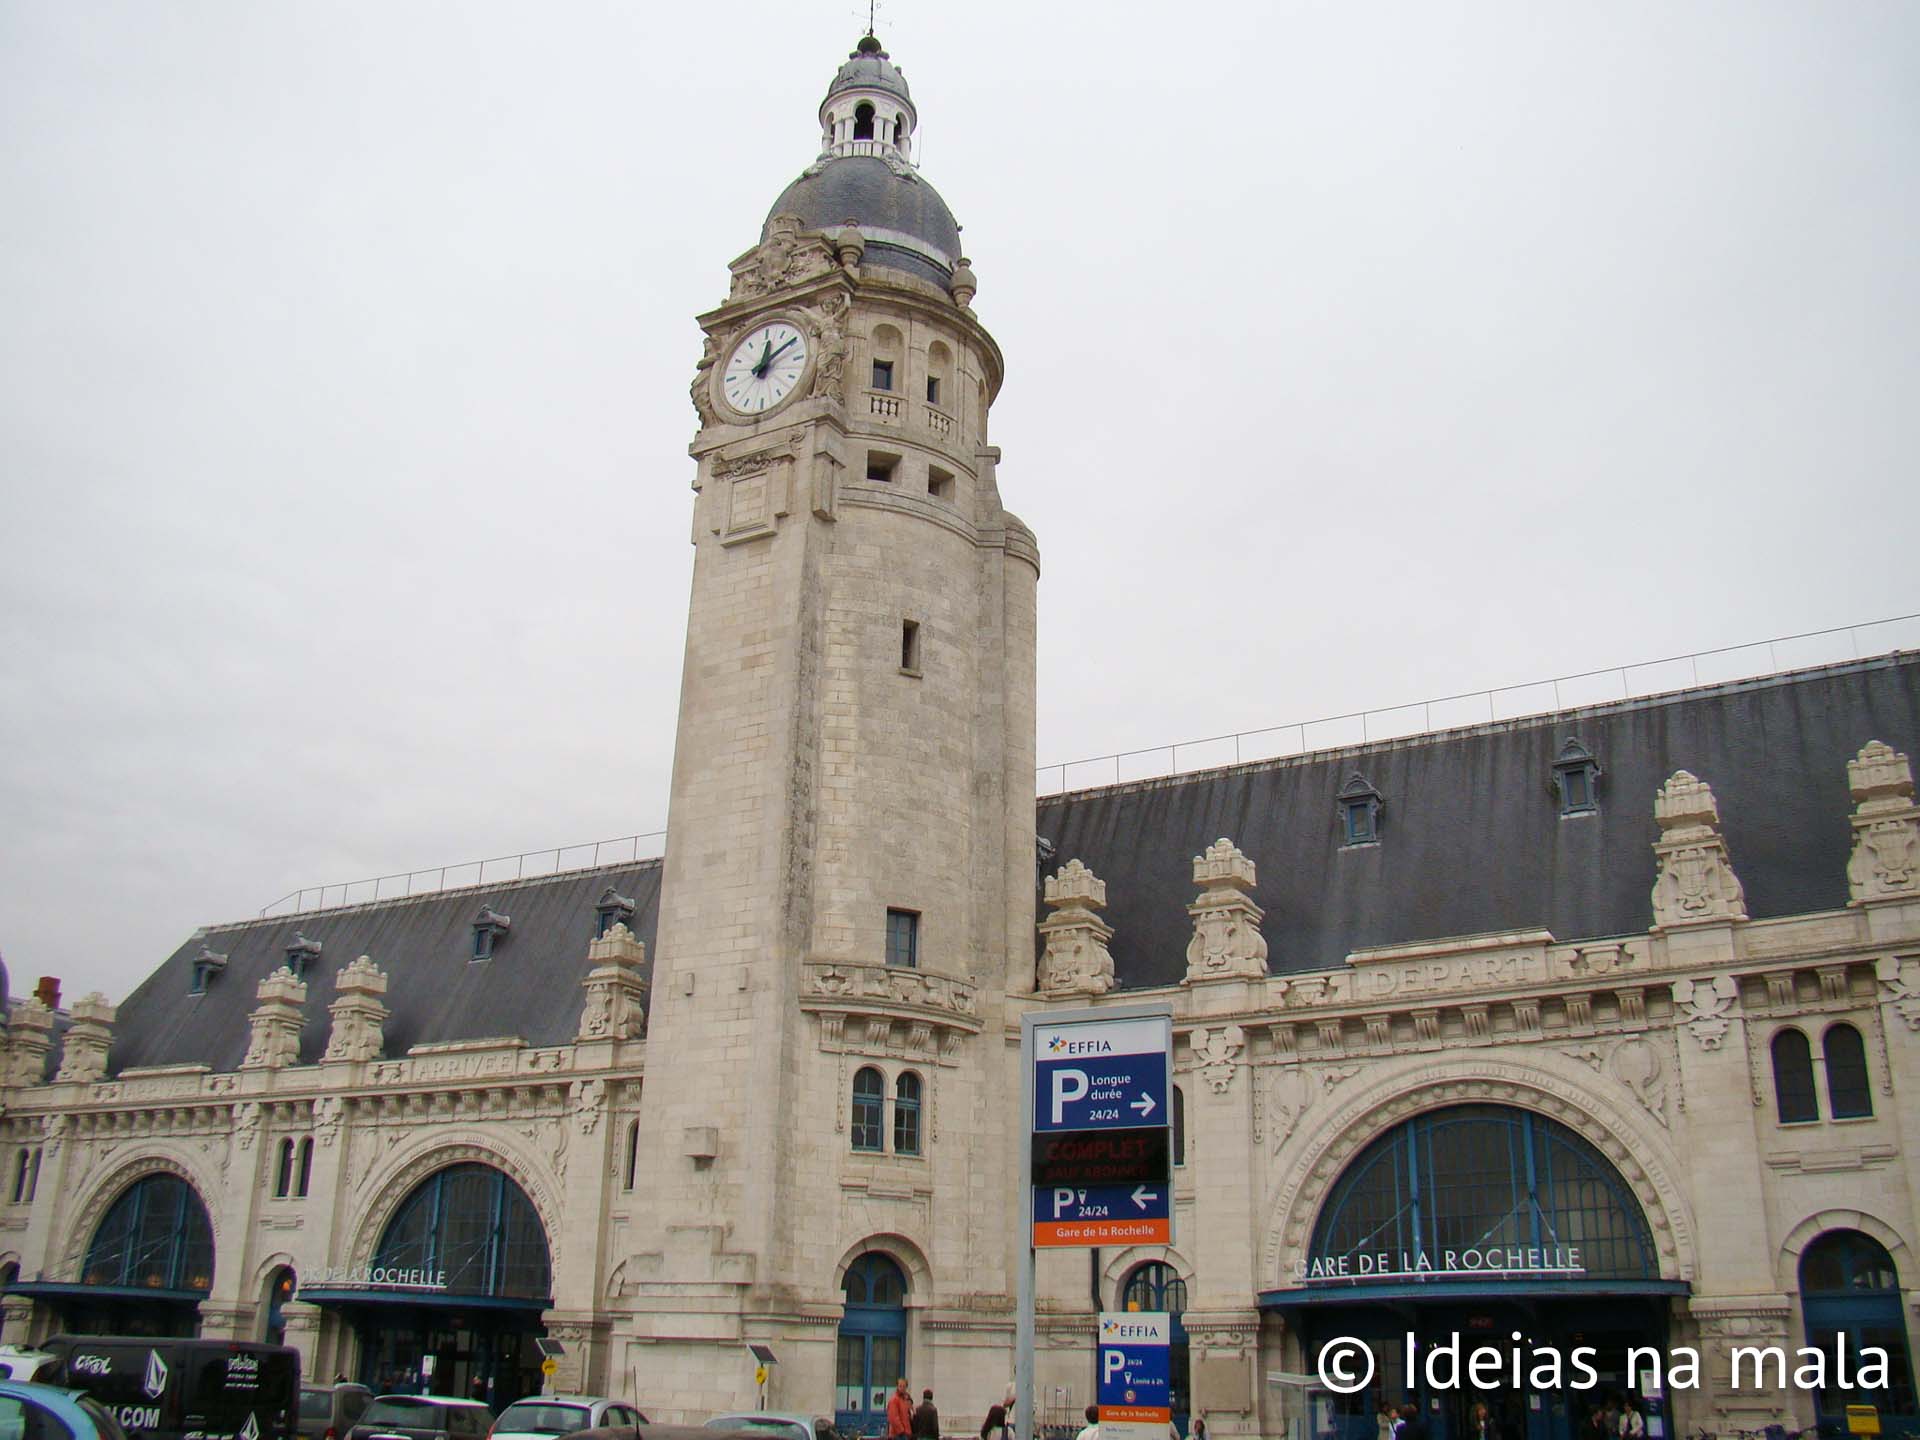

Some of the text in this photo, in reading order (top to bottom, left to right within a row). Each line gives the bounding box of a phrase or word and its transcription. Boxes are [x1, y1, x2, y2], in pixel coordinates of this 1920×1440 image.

[1068, 1040, 1112, 1054] EFFIA
[1091, 1075, 1132, 1087] Longue
[1052, 1068, 1089, 1124] P
[1090, 1089, 1122, 1100] durée
[1089, 1109, 1120, 1121] 24/24
[1045, 1137, 1149, 1160] COMPLET
[1053, 1187, 1075, 1218] P
[1078, 1206, 1109, 1217] 24/24
[1056, 1225, 1155, 1238] Gare de la Rochelle
[1294, 1248, 1581, 1279] GARE DE LA ROCHELLE
[364, 1266, 446, 1286] ROCHELLE
[1120, 1325, 1159, 1337] EFFIA
[1104, 1349, 1125, 1385] P
[110, 1406, 160, 1428] COM
